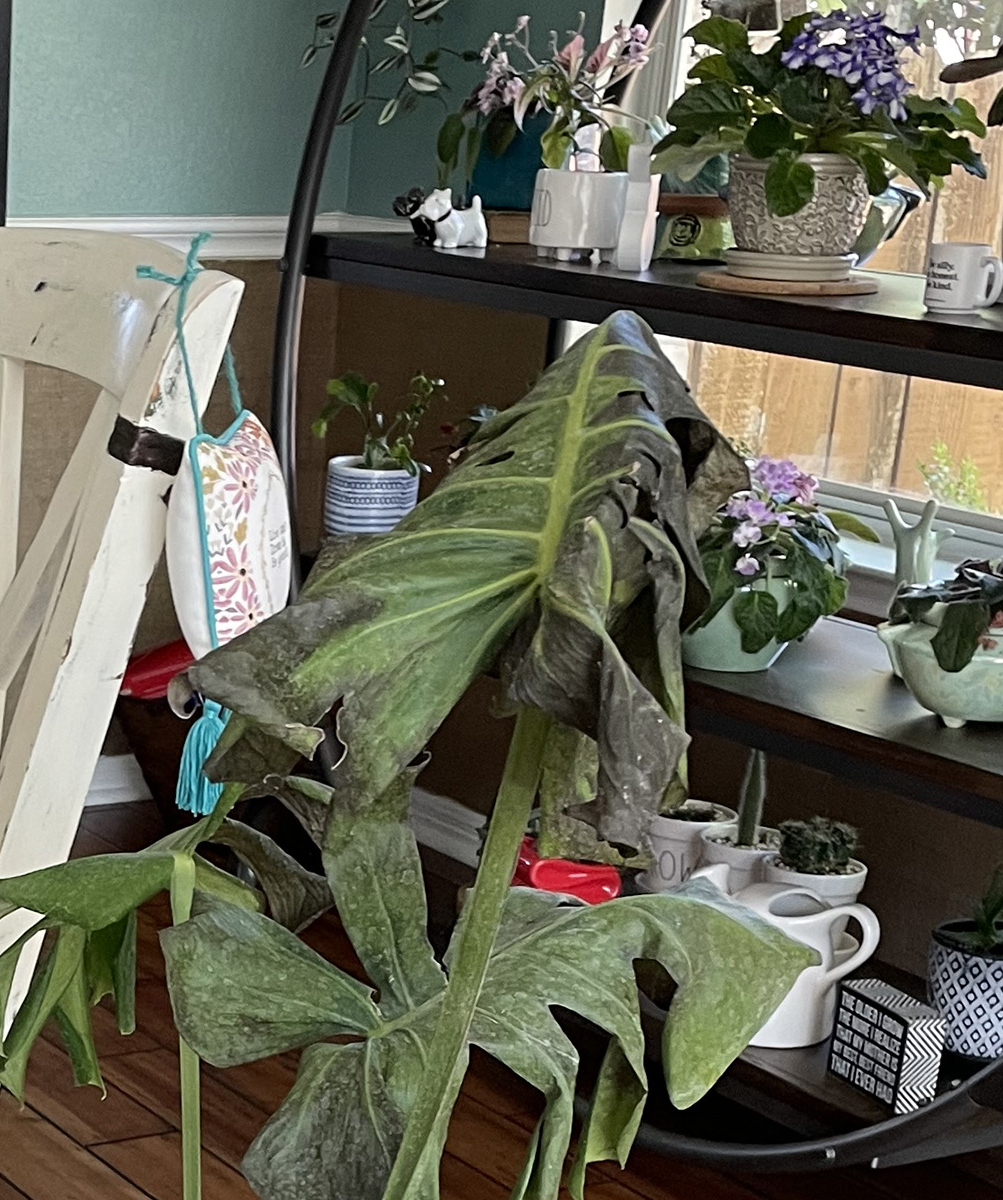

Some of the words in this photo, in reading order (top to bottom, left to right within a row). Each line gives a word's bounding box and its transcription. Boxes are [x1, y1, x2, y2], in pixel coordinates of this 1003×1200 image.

[831, 1052, 851, 1078] THAT
[850, 1065, 856, 1082] I
[854, 1068, 876, 1094] EVER
[876, 1081, 894, 1104] HAD
[874, 1063, 896, 1086] FRIEND
